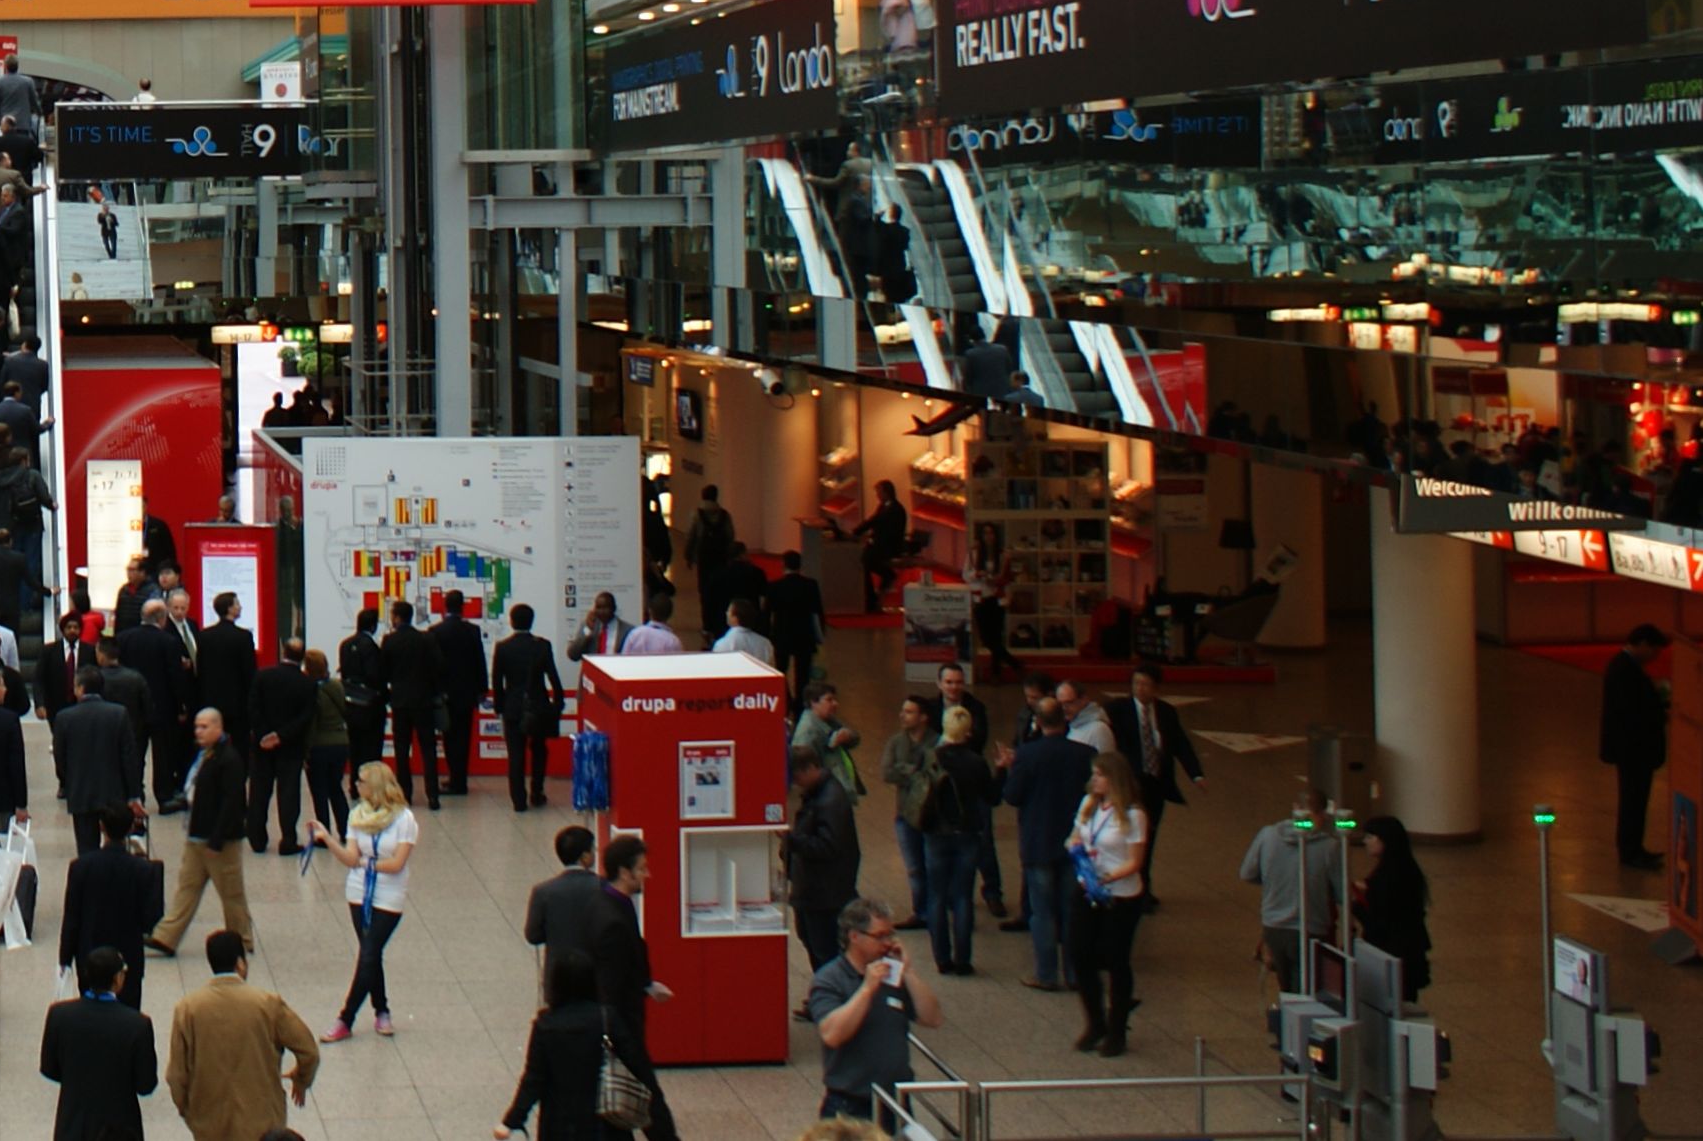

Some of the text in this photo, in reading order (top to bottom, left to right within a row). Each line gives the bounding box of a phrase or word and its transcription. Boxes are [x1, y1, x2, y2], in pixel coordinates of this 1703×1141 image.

[955, 2, 1086, 67] REALLY FAST.
[756, 35, 769, 97] 9
[69, 125, 156, 144] IT'S TIME.
[252, 124, 276, 158] 9
[622, 695, 676, 714] drupa
[734, 692, 779, 713] daily
